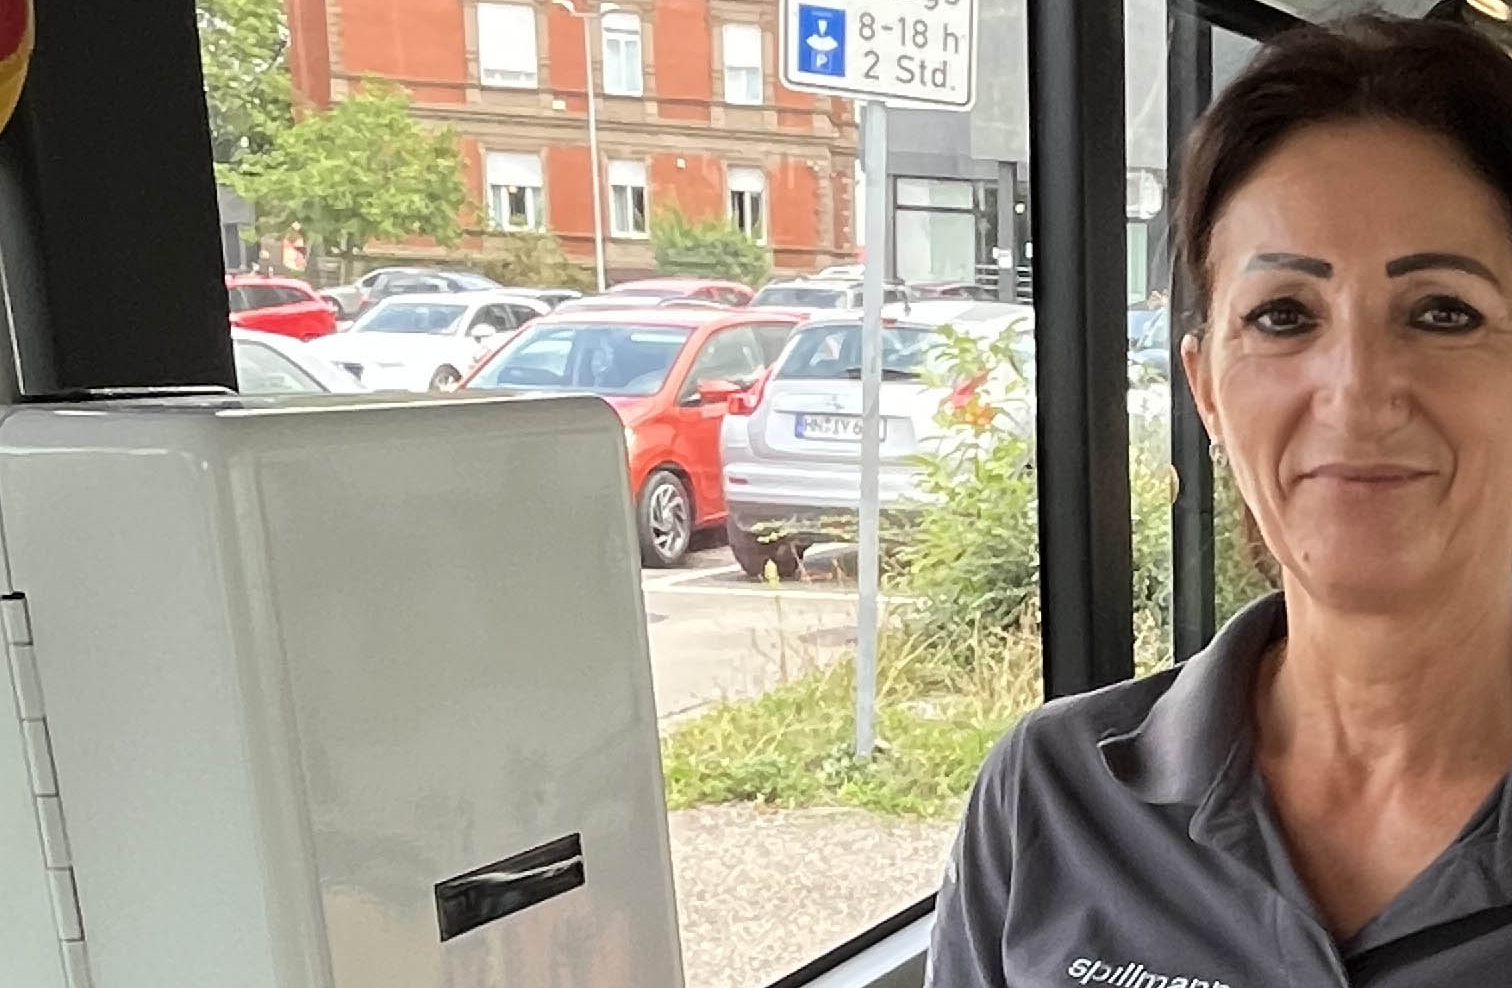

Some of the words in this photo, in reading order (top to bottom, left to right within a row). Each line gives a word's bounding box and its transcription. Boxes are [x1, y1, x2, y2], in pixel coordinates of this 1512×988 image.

[858, 12, 928, 49] 8-18
[943, 23, 959, 54] h
[863, 50, 880, 81] 2
[895, 54, 956, 91] Std.
